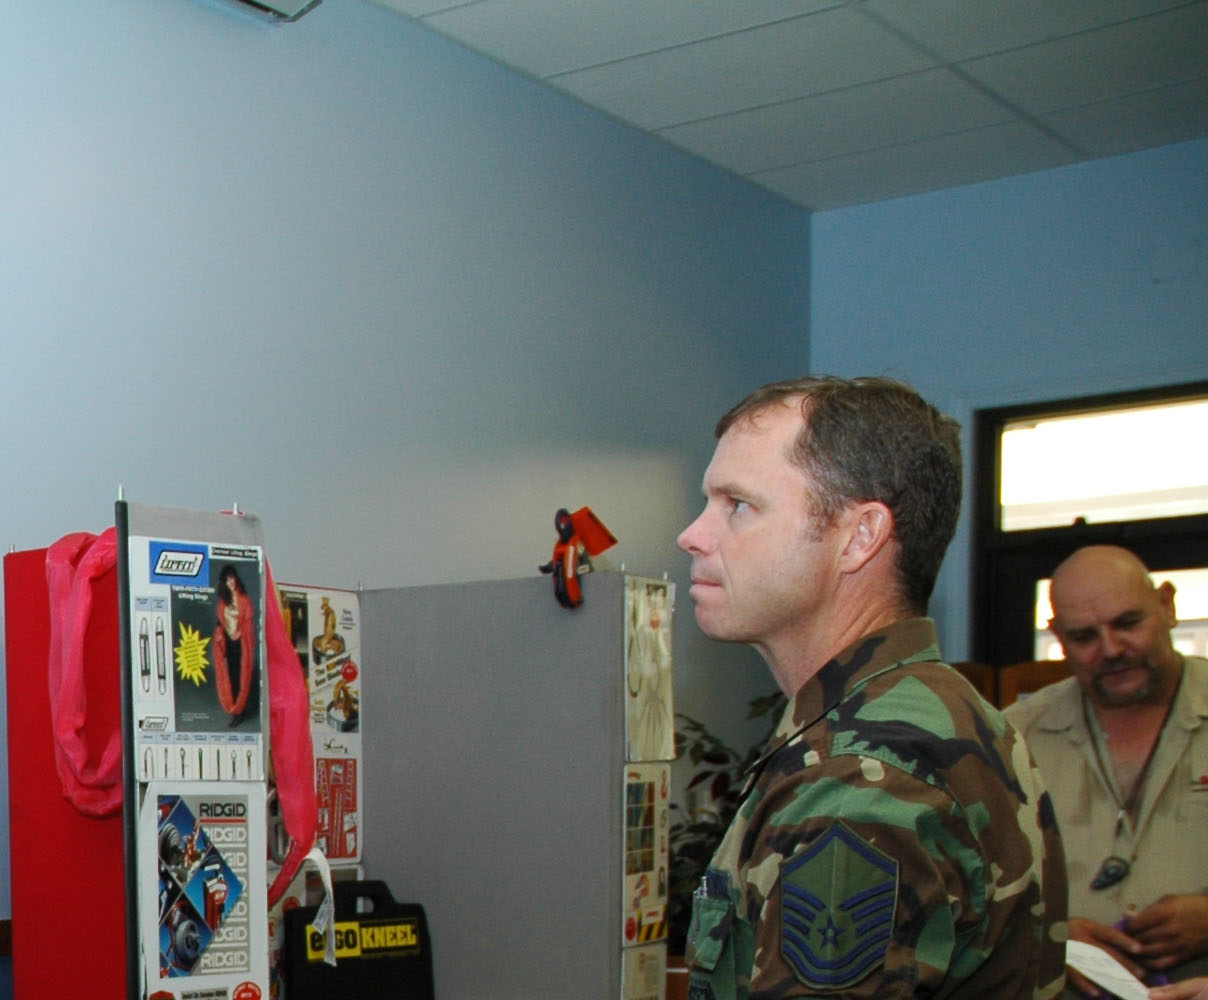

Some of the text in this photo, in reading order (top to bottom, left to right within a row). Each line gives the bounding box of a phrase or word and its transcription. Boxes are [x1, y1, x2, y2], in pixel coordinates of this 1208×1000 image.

[199, 803, 246, 817] RIDGID
[310, 925, 417, 952] ego KNEEL
[201, 951, 248, 967] RIDGID
